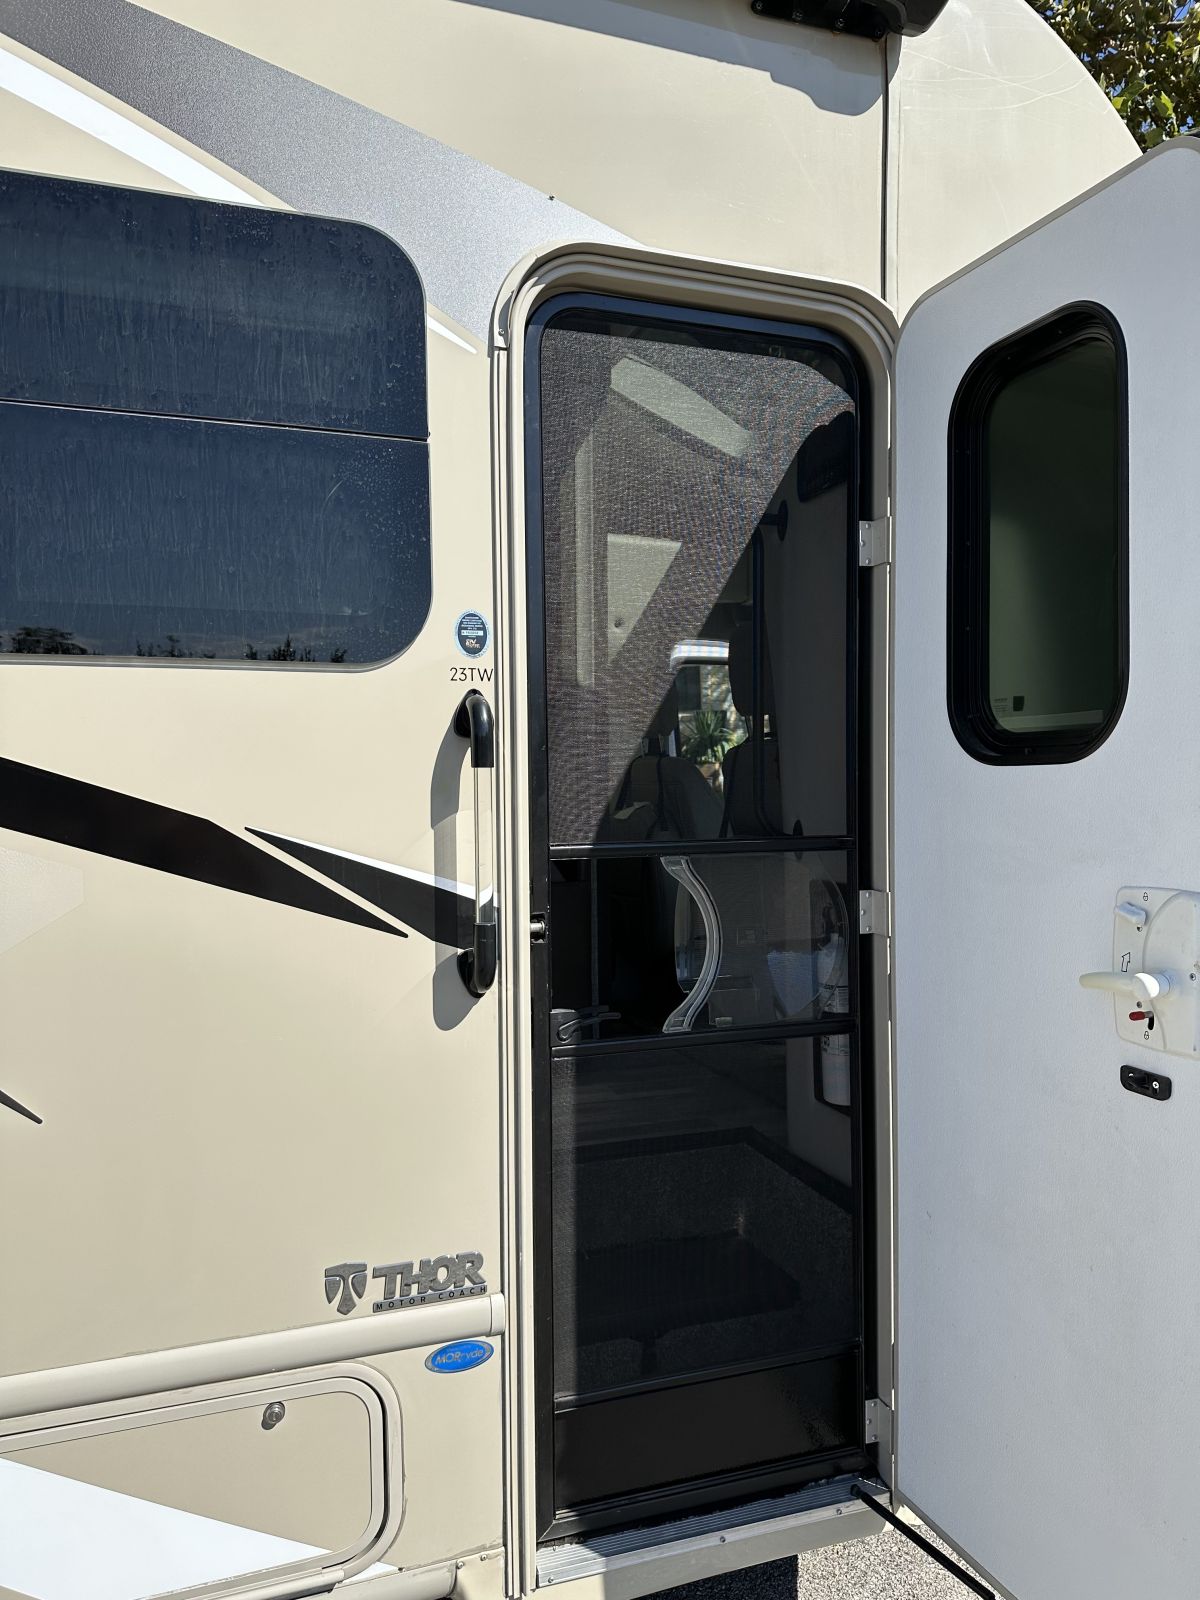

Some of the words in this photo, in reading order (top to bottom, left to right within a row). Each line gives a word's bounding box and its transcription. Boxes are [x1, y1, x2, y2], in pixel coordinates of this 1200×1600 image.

[449, 667, 494, 682] 23TW
[372, 1251, 487, 1300] THOR
[376, 1296, 427, 1310] MOTOR
[438, 1287, 487, 1300] COACH
